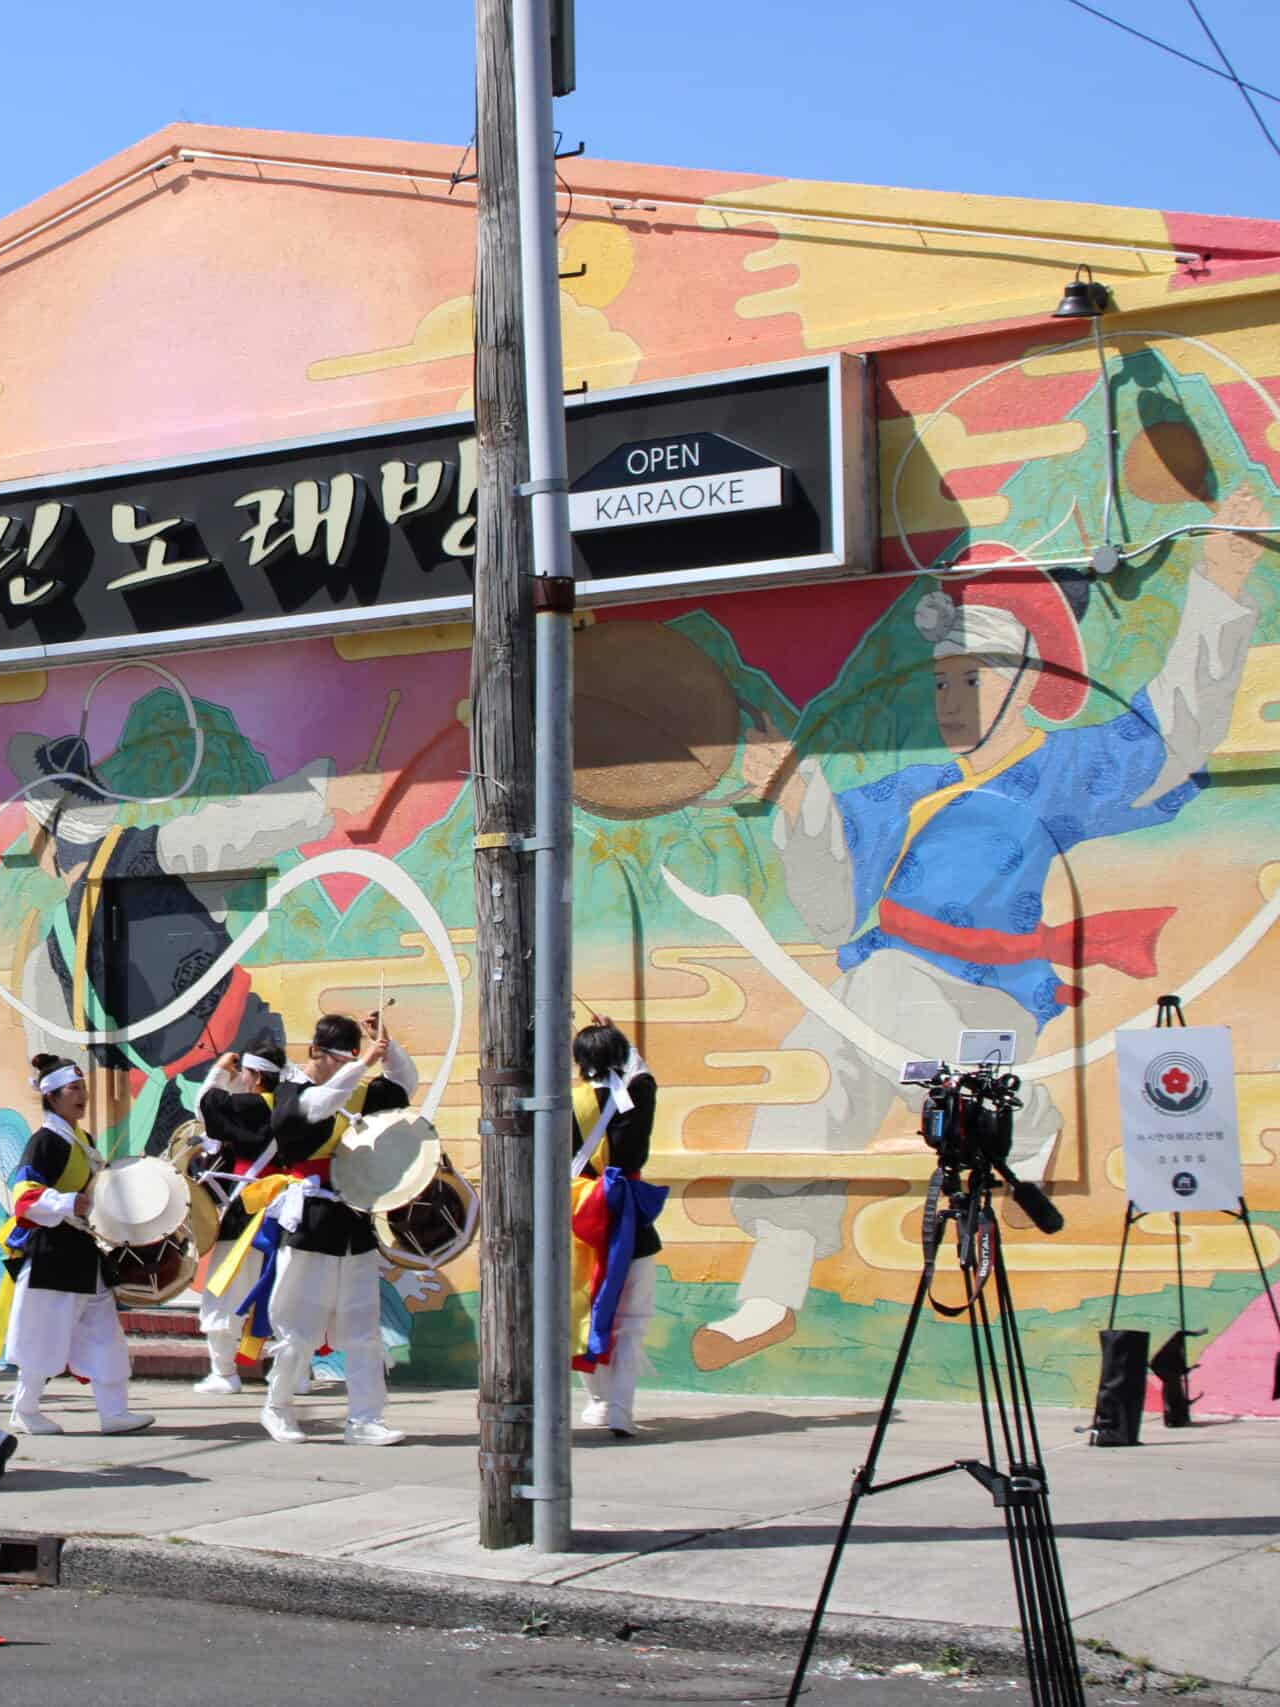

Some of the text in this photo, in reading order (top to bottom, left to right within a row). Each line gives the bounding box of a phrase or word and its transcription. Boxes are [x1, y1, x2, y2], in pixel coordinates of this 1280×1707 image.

[626, 441, 700, 475] OPEN
[106, 437, 478, 591] 노래방
[595, 479, 745, 521] KARAOKE
